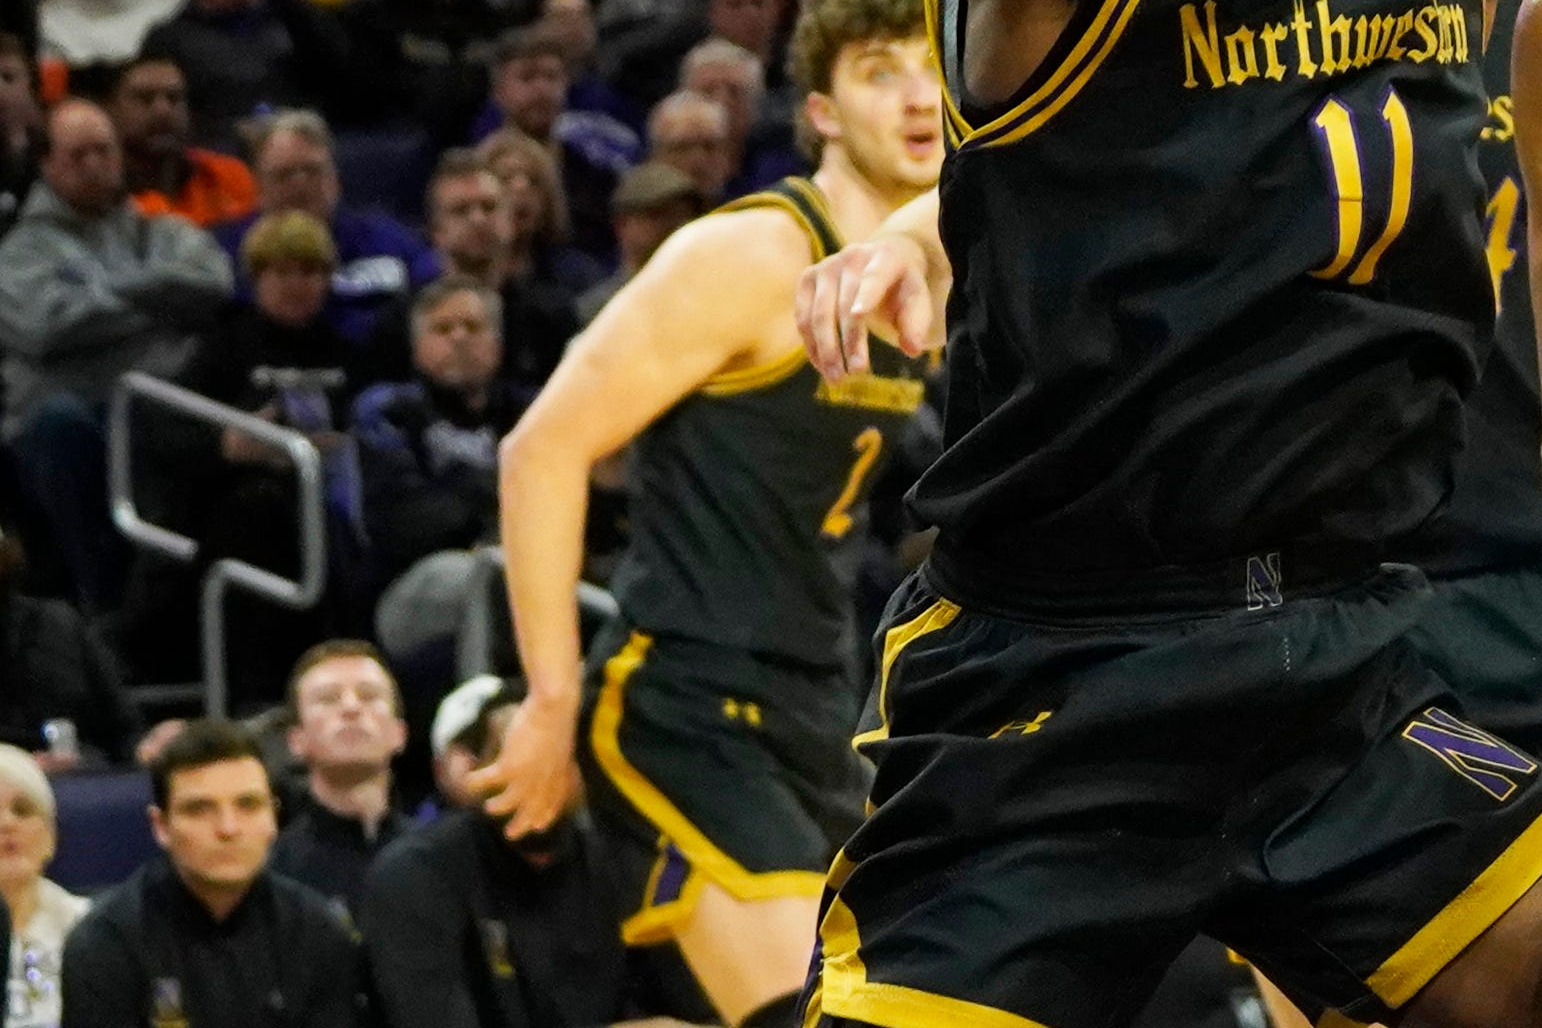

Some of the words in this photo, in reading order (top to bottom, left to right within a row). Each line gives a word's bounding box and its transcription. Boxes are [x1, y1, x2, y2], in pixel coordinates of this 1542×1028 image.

[1308, 85, 1414, 285] 11
[822, 426, 882, 538] 2
[1402, 706, 1537, 801] N
